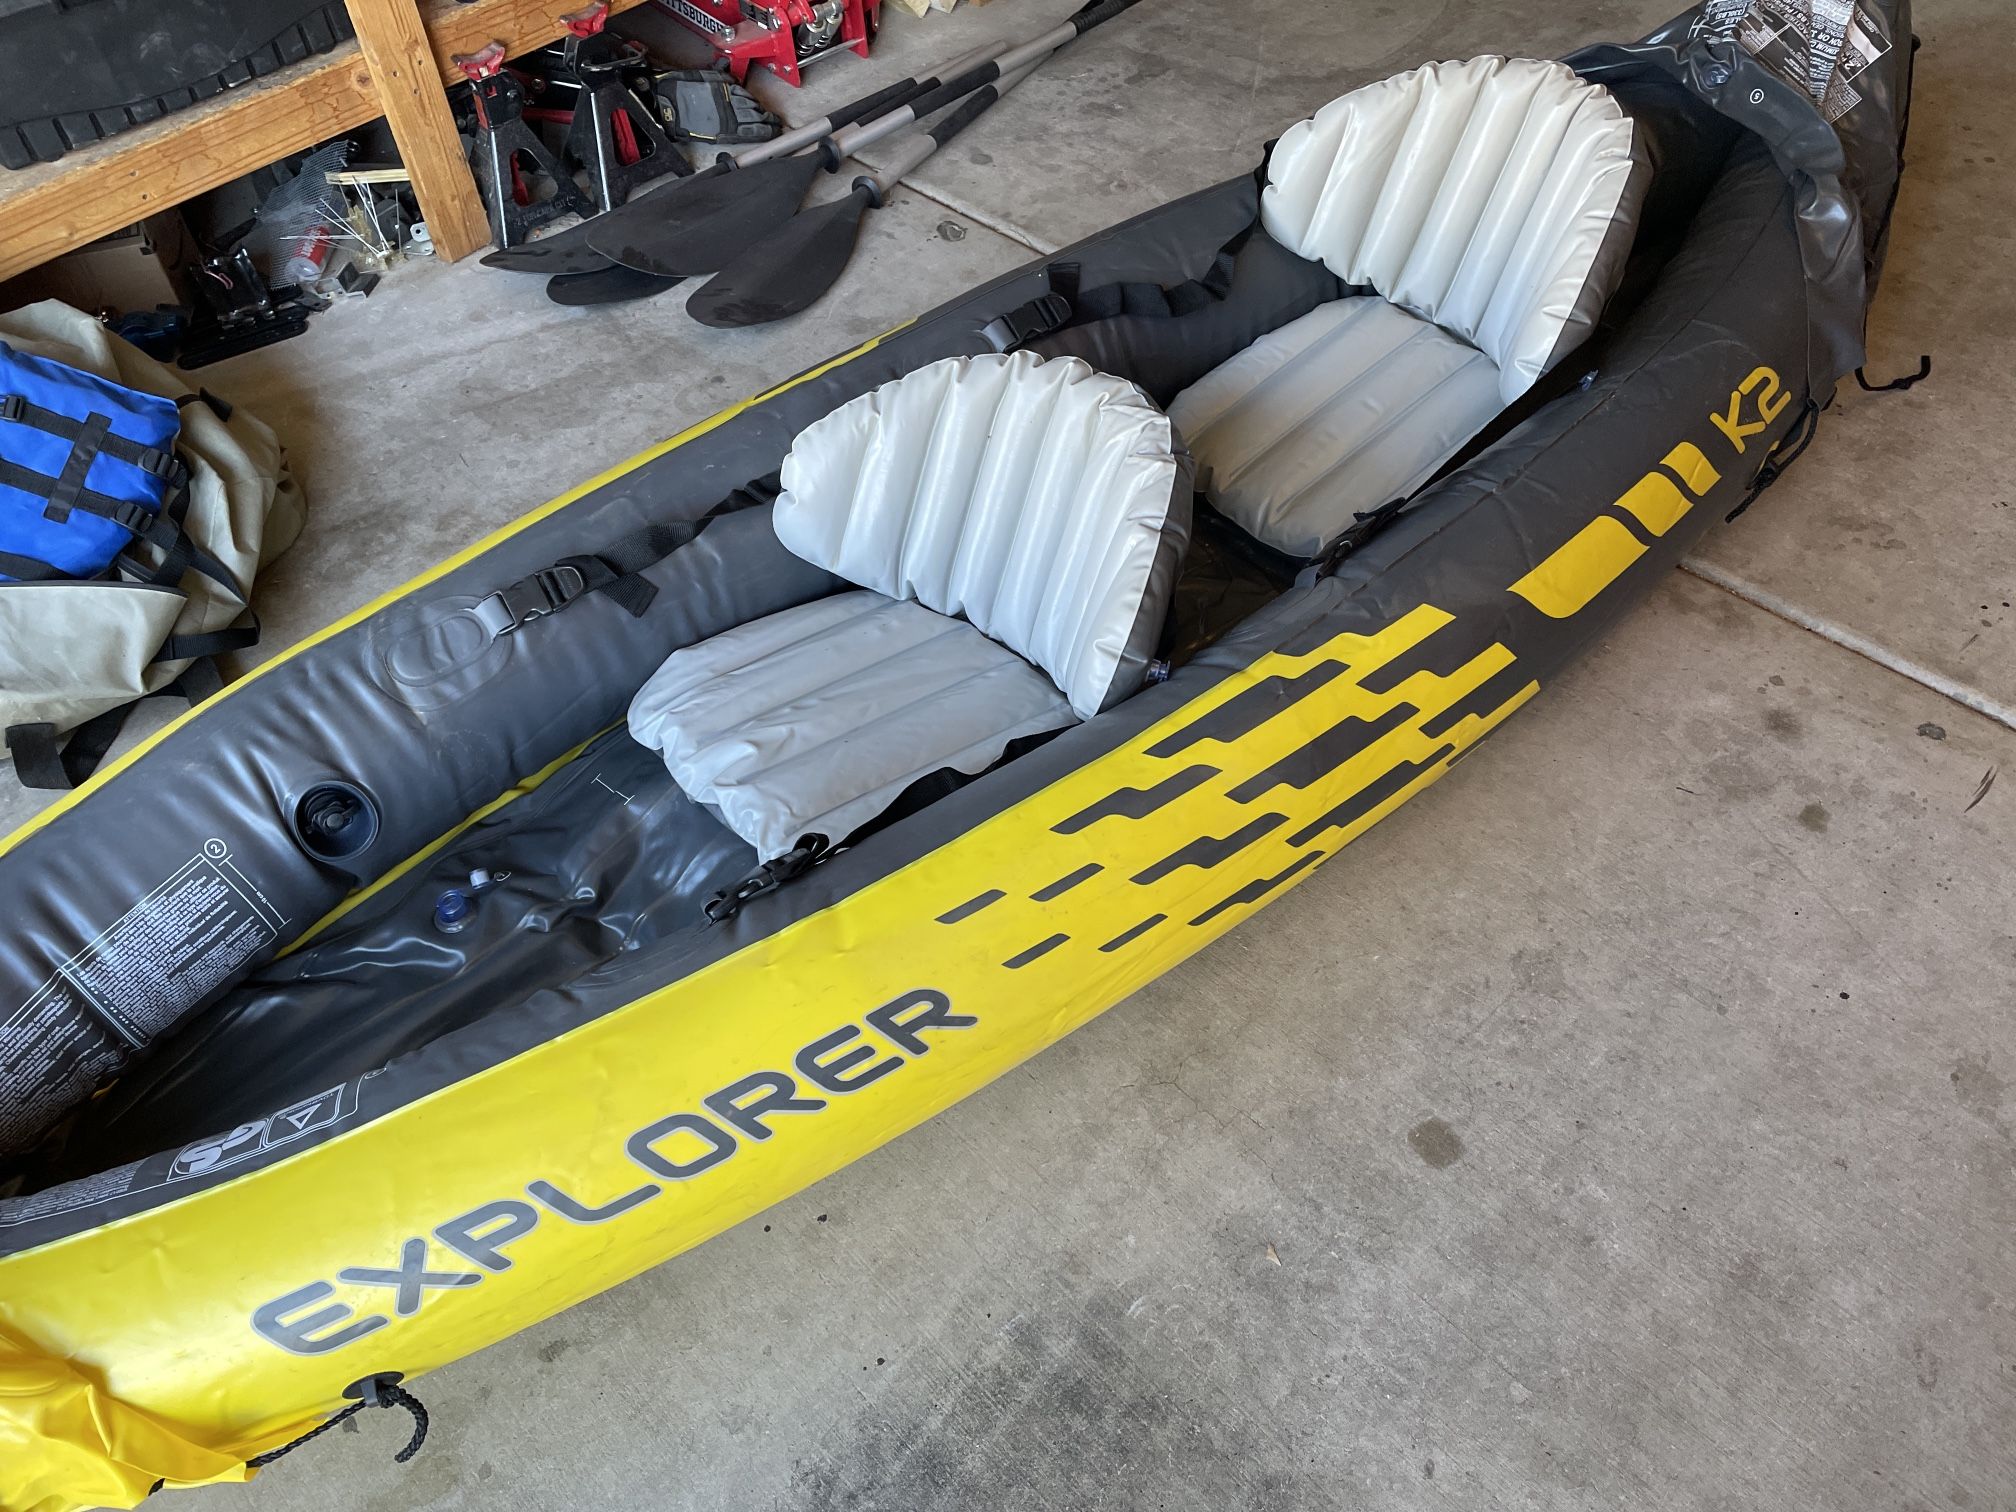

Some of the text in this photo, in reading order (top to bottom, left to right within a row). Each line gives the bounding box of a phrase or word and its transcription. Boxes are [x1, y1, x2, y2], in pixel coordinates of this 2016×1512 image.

[660, 0, 725, 32] TTSBURGH
[1709, 366, 1792, 455] K2
[210, 844, 221, 854] 2
[122, 901, 147, 923] ATTENTION
[252, 988, 978, 1356] EXPLORER
